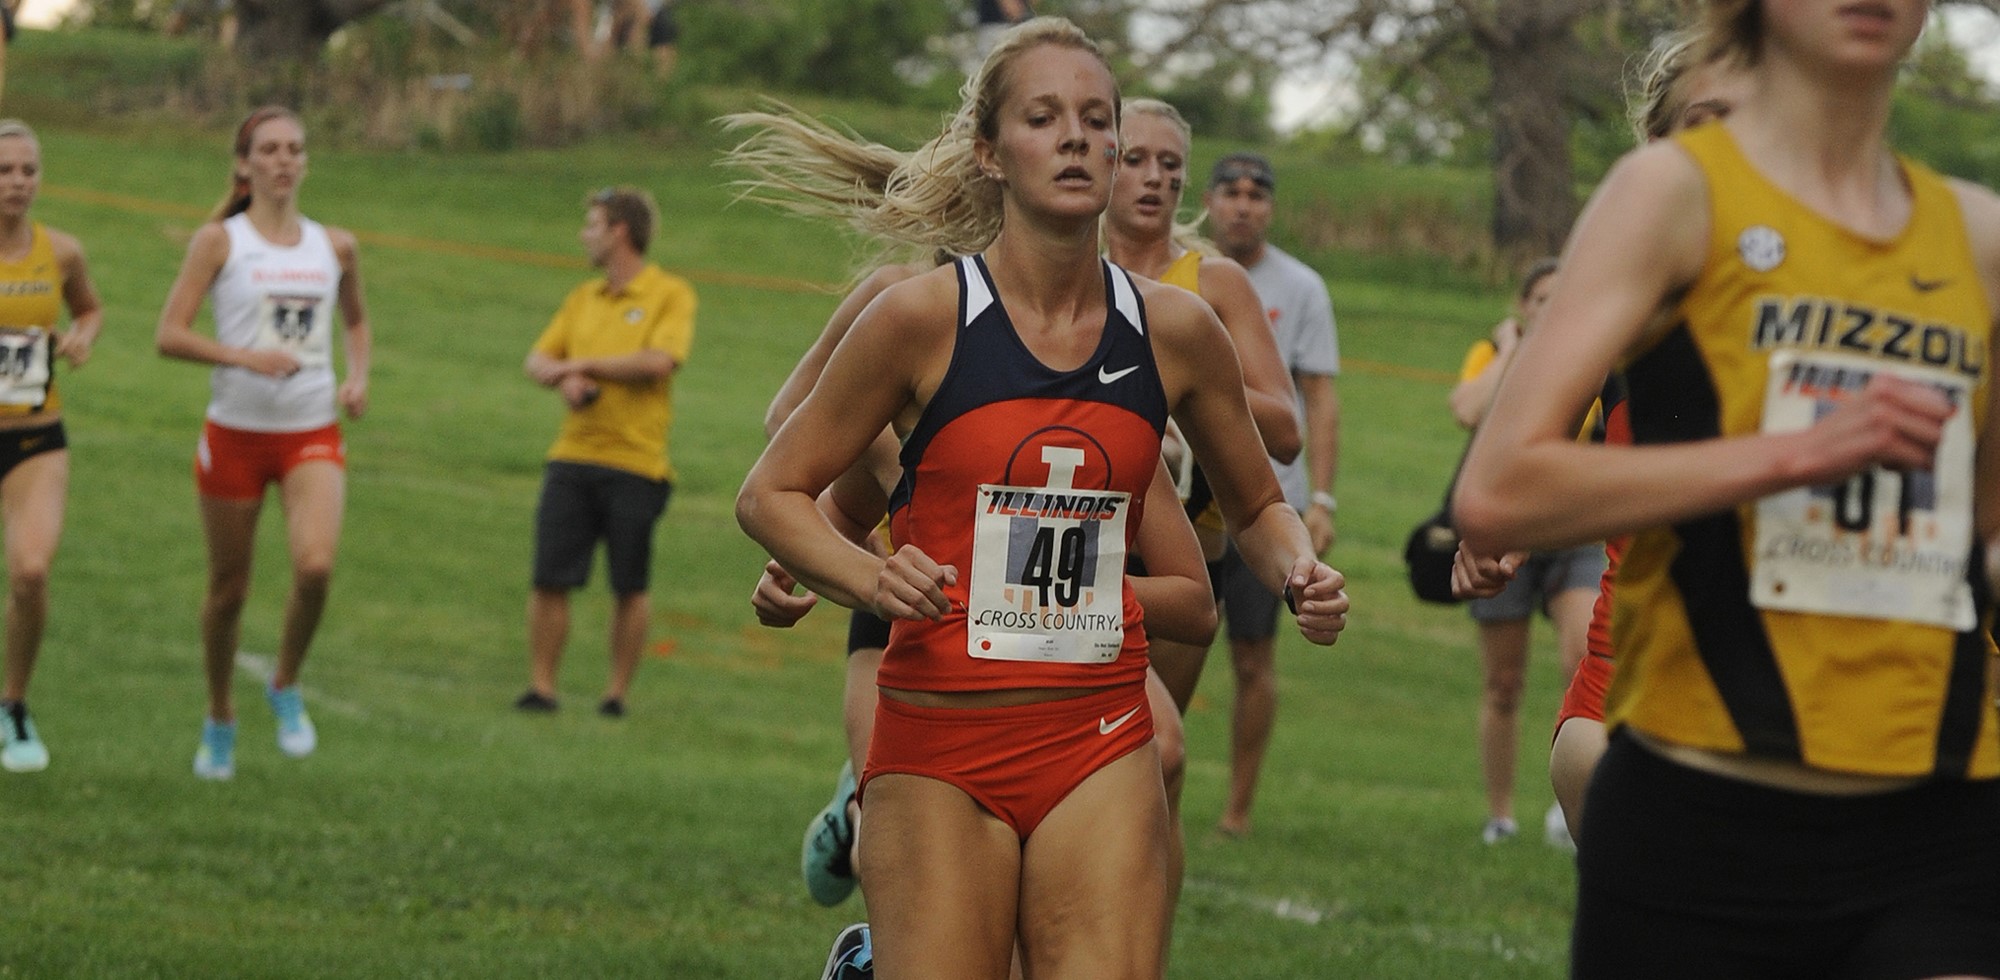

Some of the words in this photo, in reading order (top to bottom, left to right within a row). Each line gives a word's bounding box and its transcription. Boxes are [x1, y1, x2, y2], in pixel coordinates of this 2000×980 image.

[987, 490, 1126, 520] ILLINOIS
[1021, 526, 1086, 607] 49
[979, 610, 1037, 629] CROSS
[1042, 613, 1117, 631] COUNTRY
